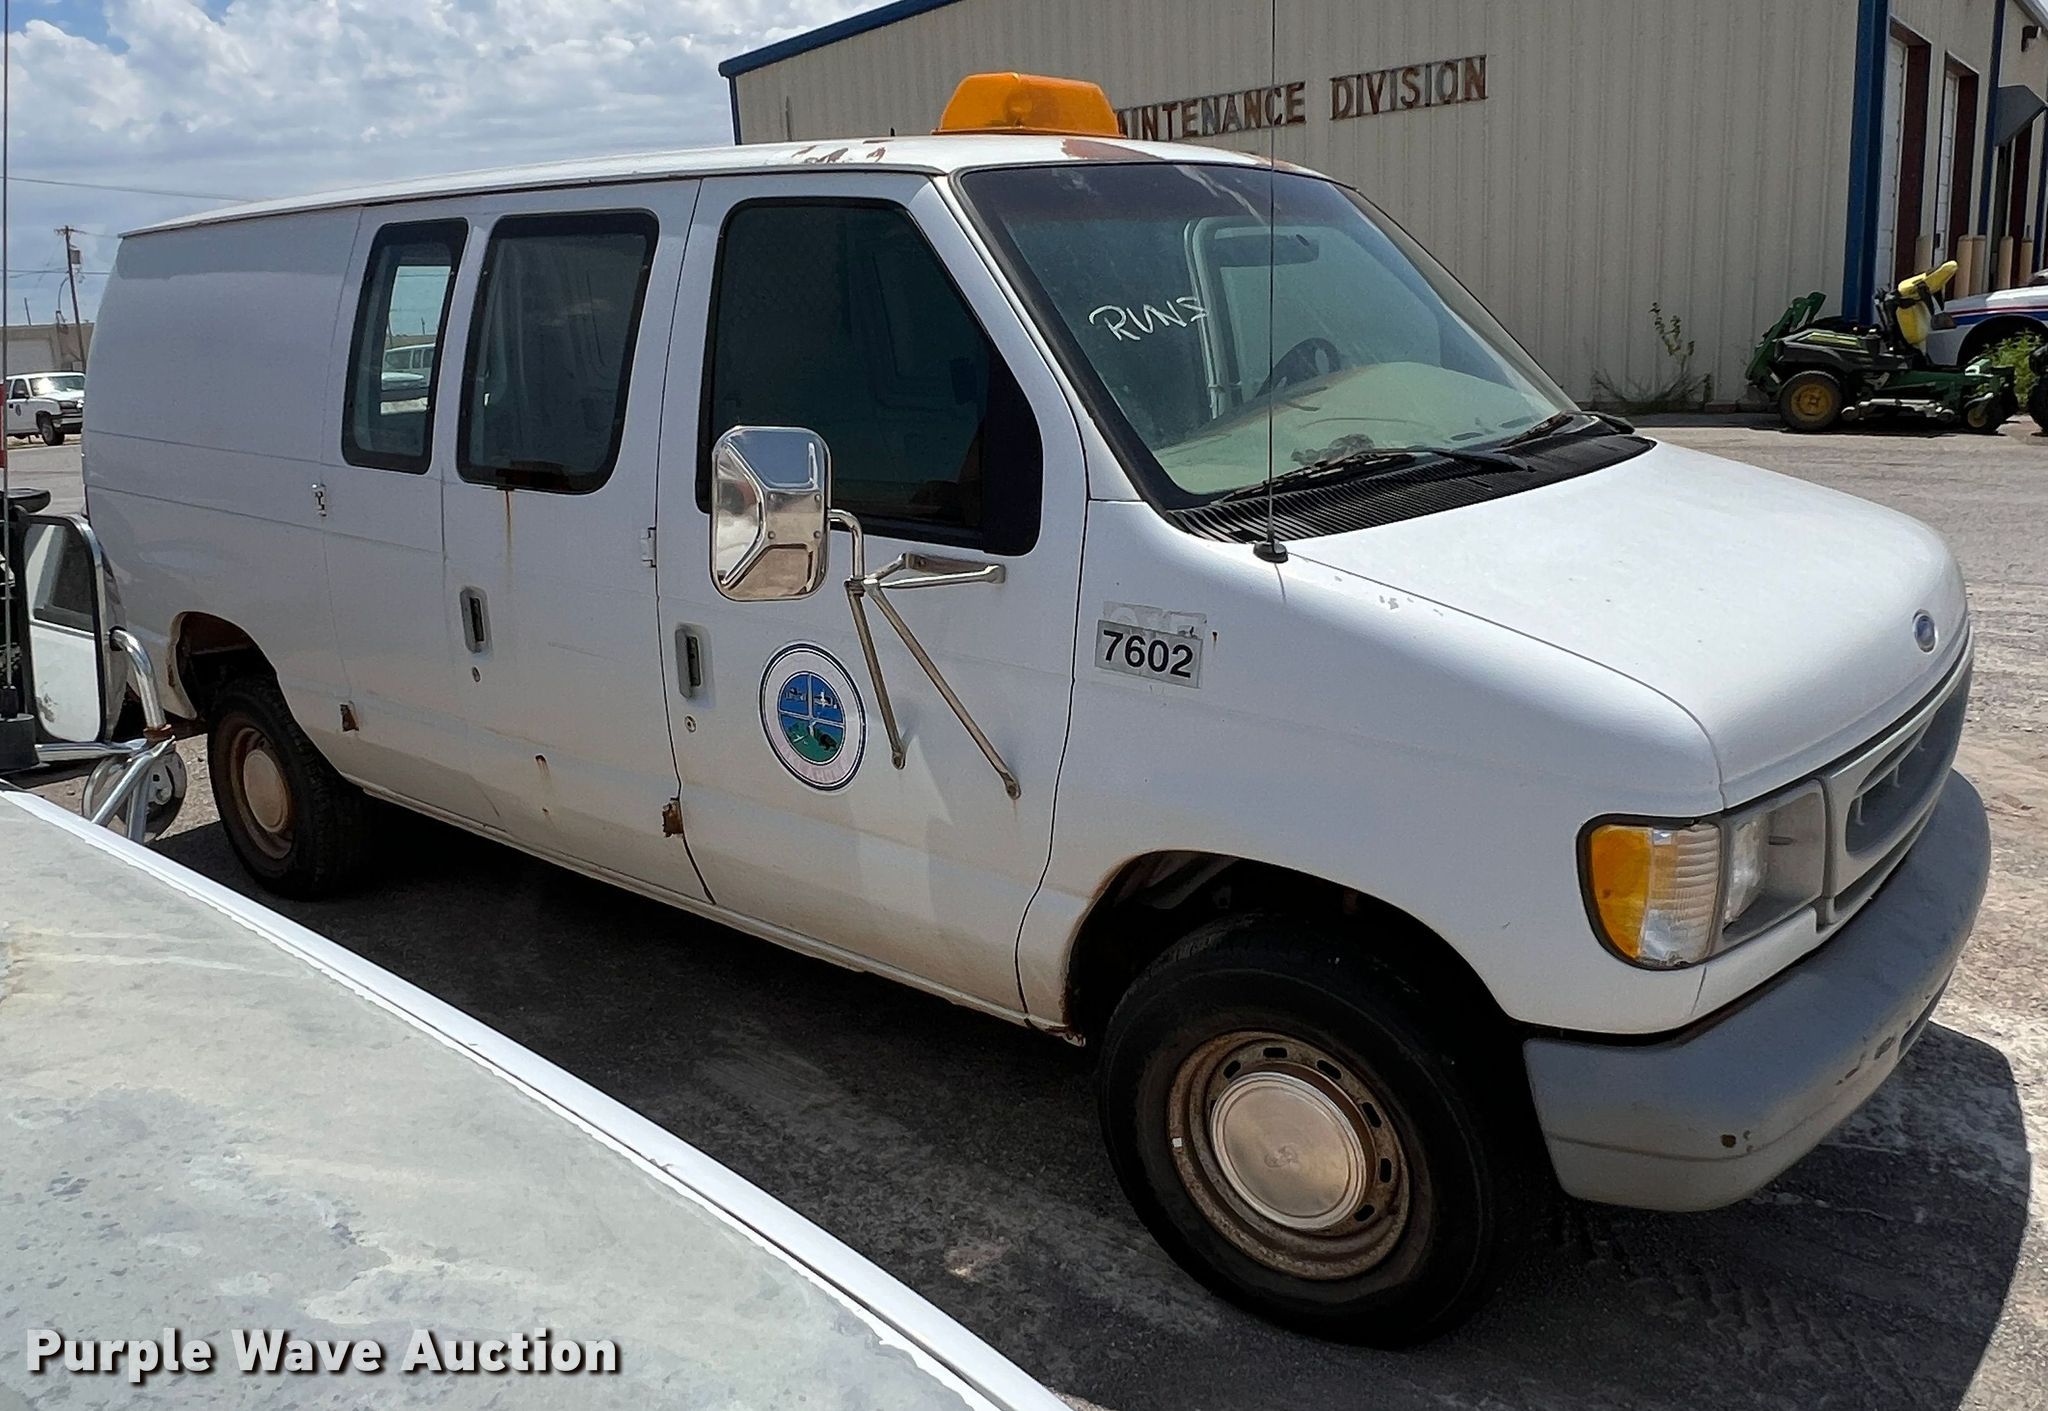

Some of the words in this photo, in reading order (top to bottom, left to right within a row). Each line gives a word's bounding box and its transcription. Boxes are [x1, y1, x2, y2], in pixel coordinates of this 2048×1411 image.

[1330, 54, 1488, 120] DIVISION
[1089, 296, 1209, 341] RUNS
[1103, 629, 1193, 678] 7602
